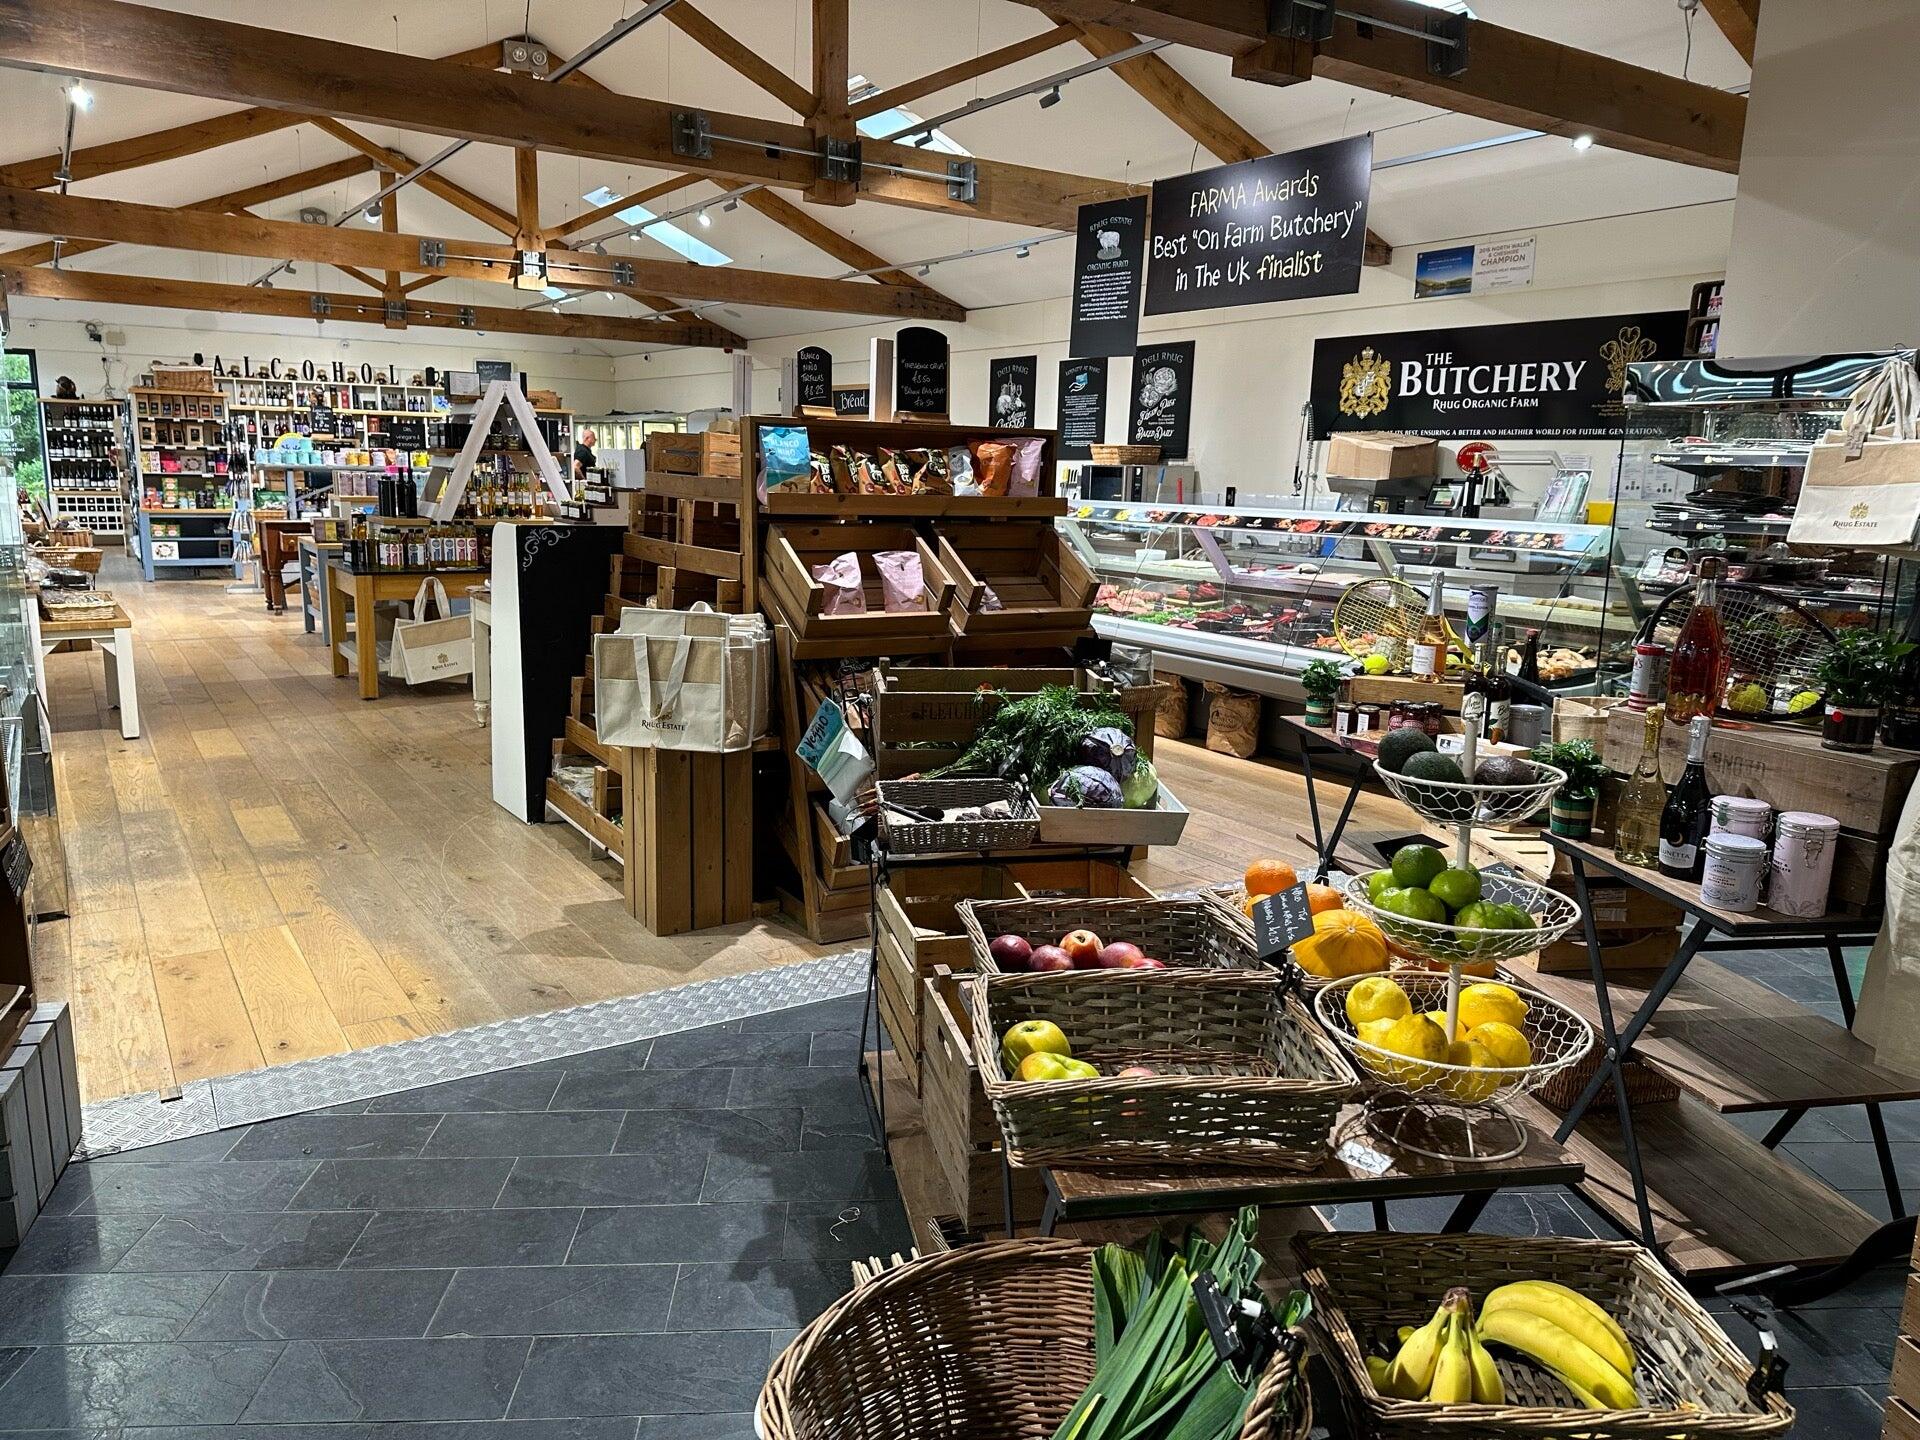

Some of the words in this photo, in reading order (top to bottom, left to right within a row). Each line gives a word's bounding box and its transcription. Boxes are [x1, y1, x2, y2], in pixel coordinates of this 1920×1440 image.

[1190, 182, 1246, 218] FARMA
[1253, 169, 1320, 205] Awards
[1154, 234, 1189, 260] Best
[1223, 223, 1265, 249] Farm
[1086, 260, 1112, 272] ORGANIC
[1480, 254, 1526, 266] CHAMPION
[1175, 268, 1188, 292] in
[1195, 262, 1221, 288] The
[1228, 259, 1251, 286] UK
[1257, 249, 1324, 282] finalist
[1141, 353, 1160, 368] DELI
[1425, 352, 1453, 367] THE
[213, 355, 399, 386] ALCOHOL
[1399, 360, 1588, 397] BUTCHERY
[1432, 398, 1461, 414] RHUG
[1462, 397, 1509, 409] ORGANIC
[1510, 396, 1539, 408] FARM
[1499, 428, 1534, 436] HEALTHIER
[1536, 428, 1561, 436] WORLD
[770, 438, 800, 447] BLANCO
[1832, 520, 1854, 529] RHUG
[1854, 520, 1878, 528] ESTATE
[641, 719, 662, 731] RHUG
[662, 721, 686, 731] ESTATE
